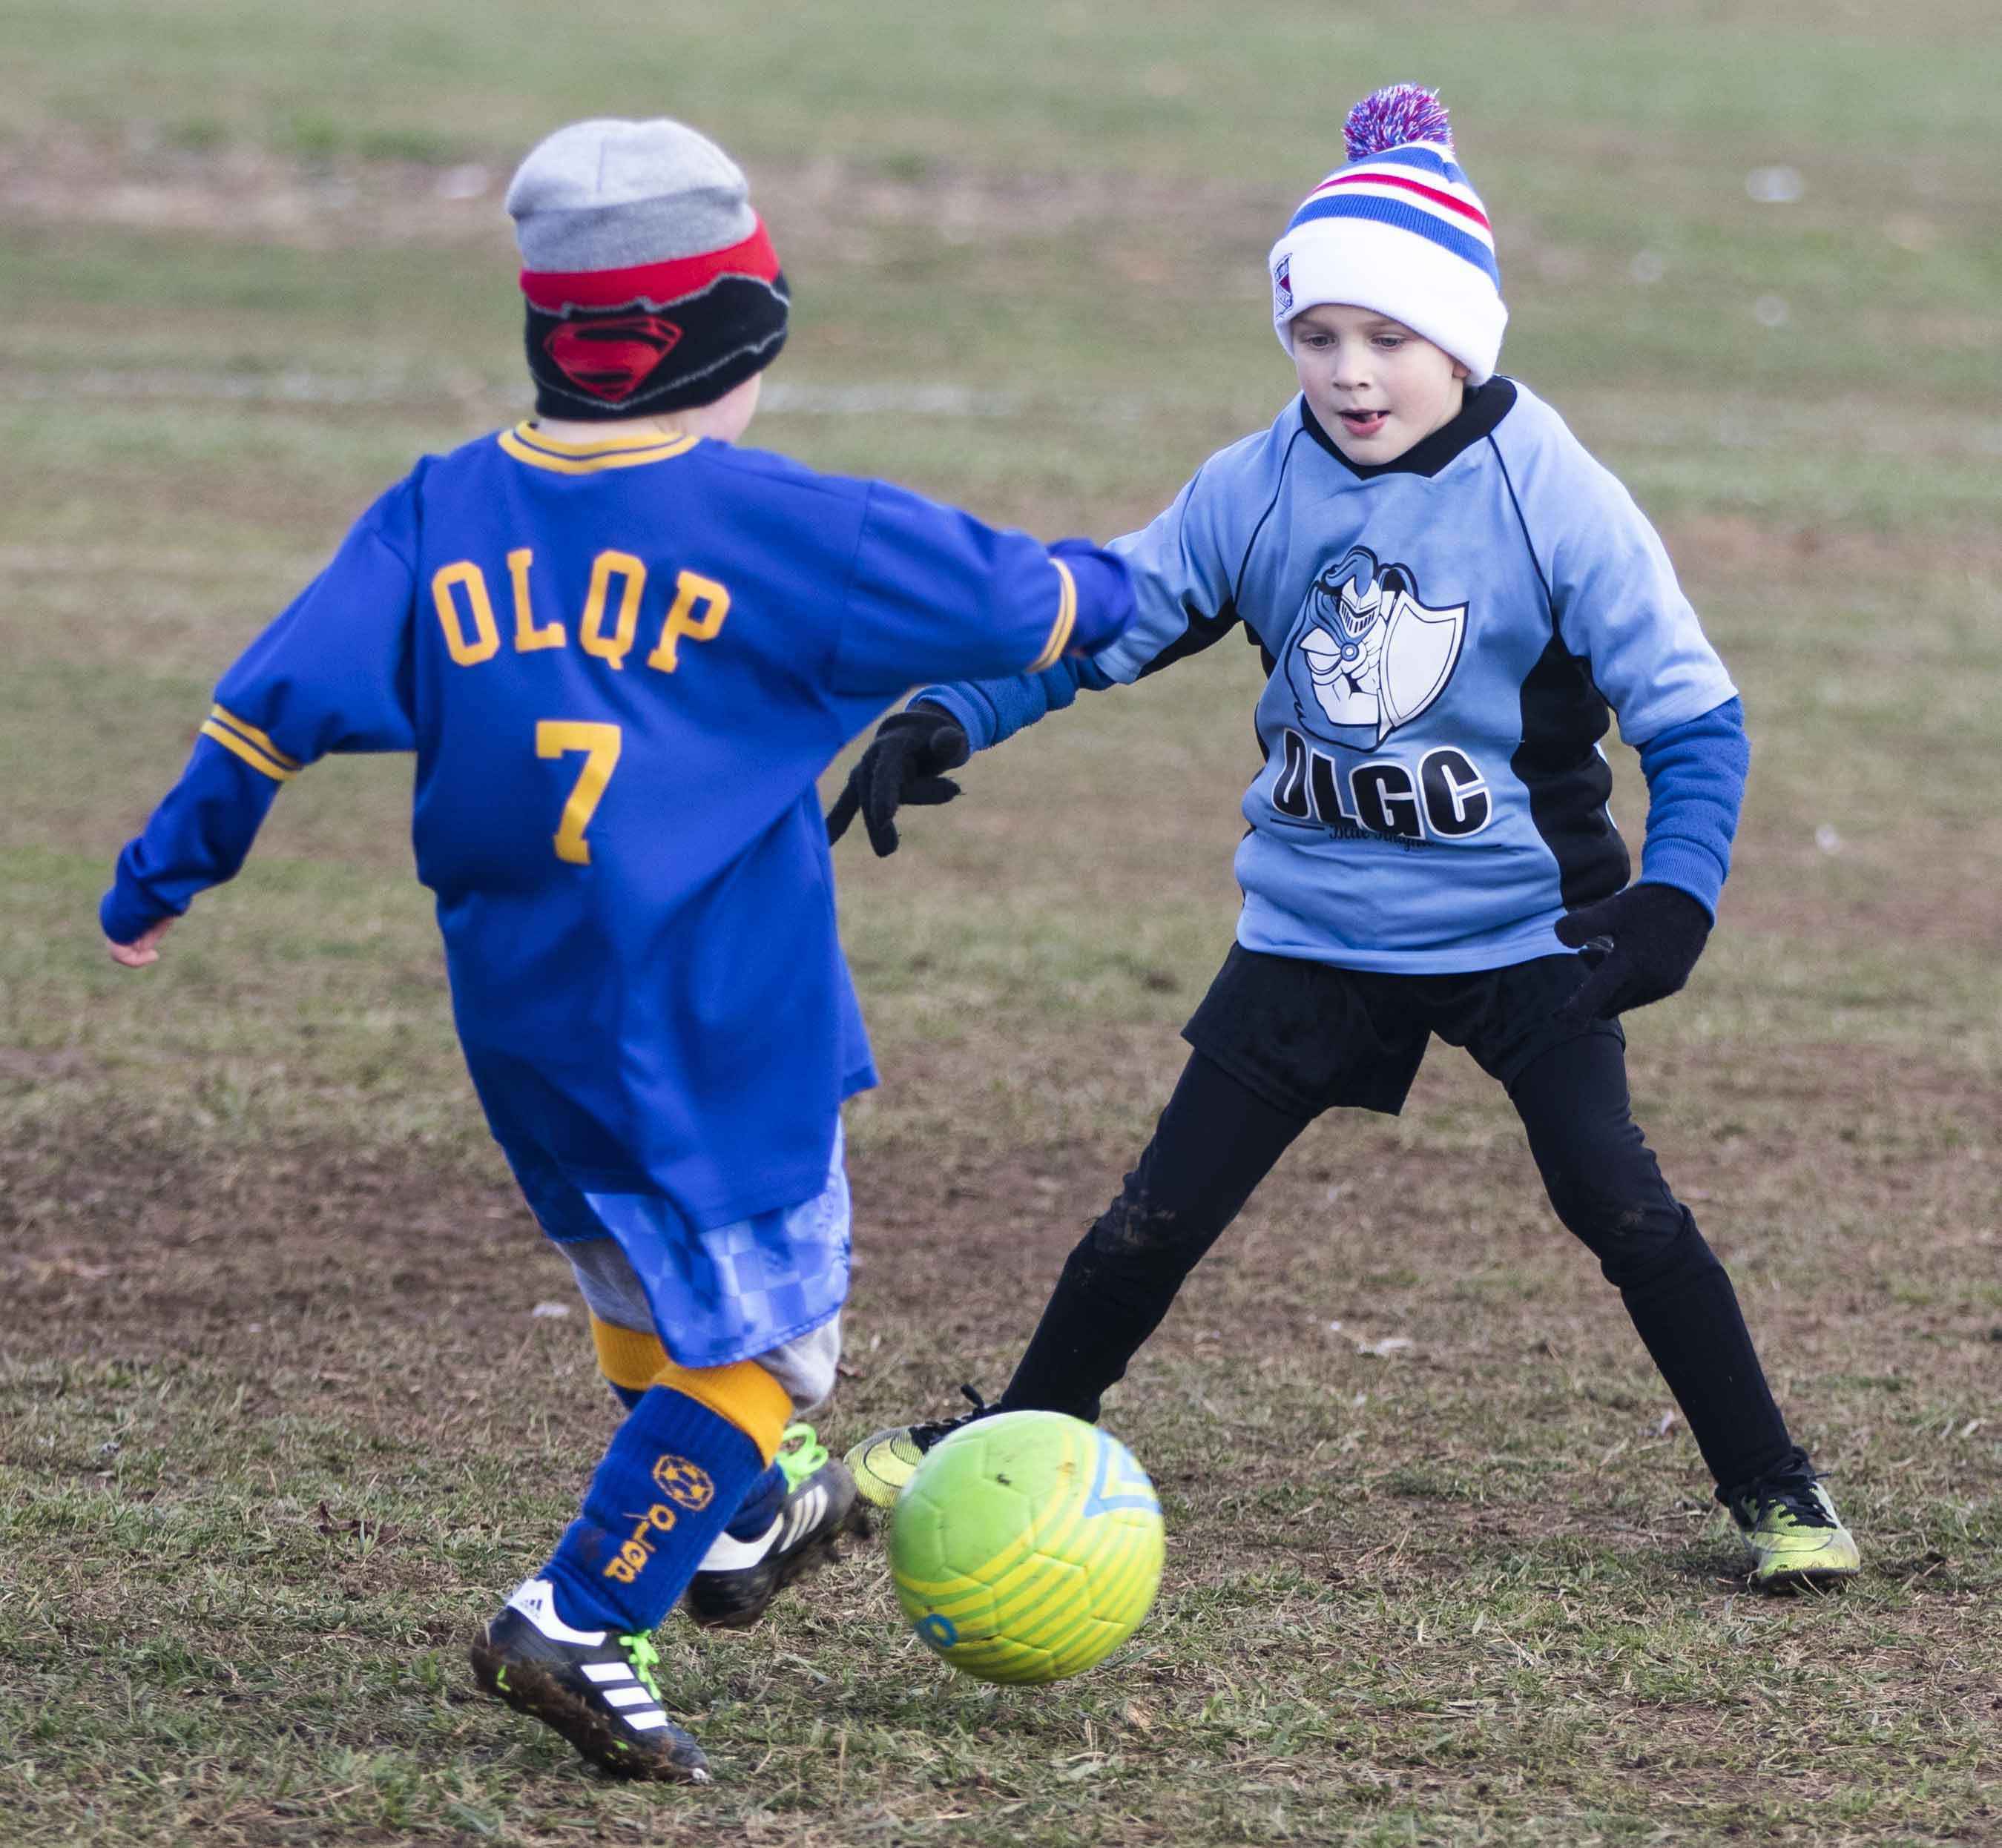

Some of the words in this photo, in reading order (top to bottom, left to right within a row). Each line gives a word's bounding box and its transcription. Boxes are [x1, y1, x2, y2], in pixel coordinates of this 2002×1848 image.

[432, 548, 731, 673] OLQP
[536, 720, 622, 865] 7
[1271, 727, 1493, 839] OLGC
